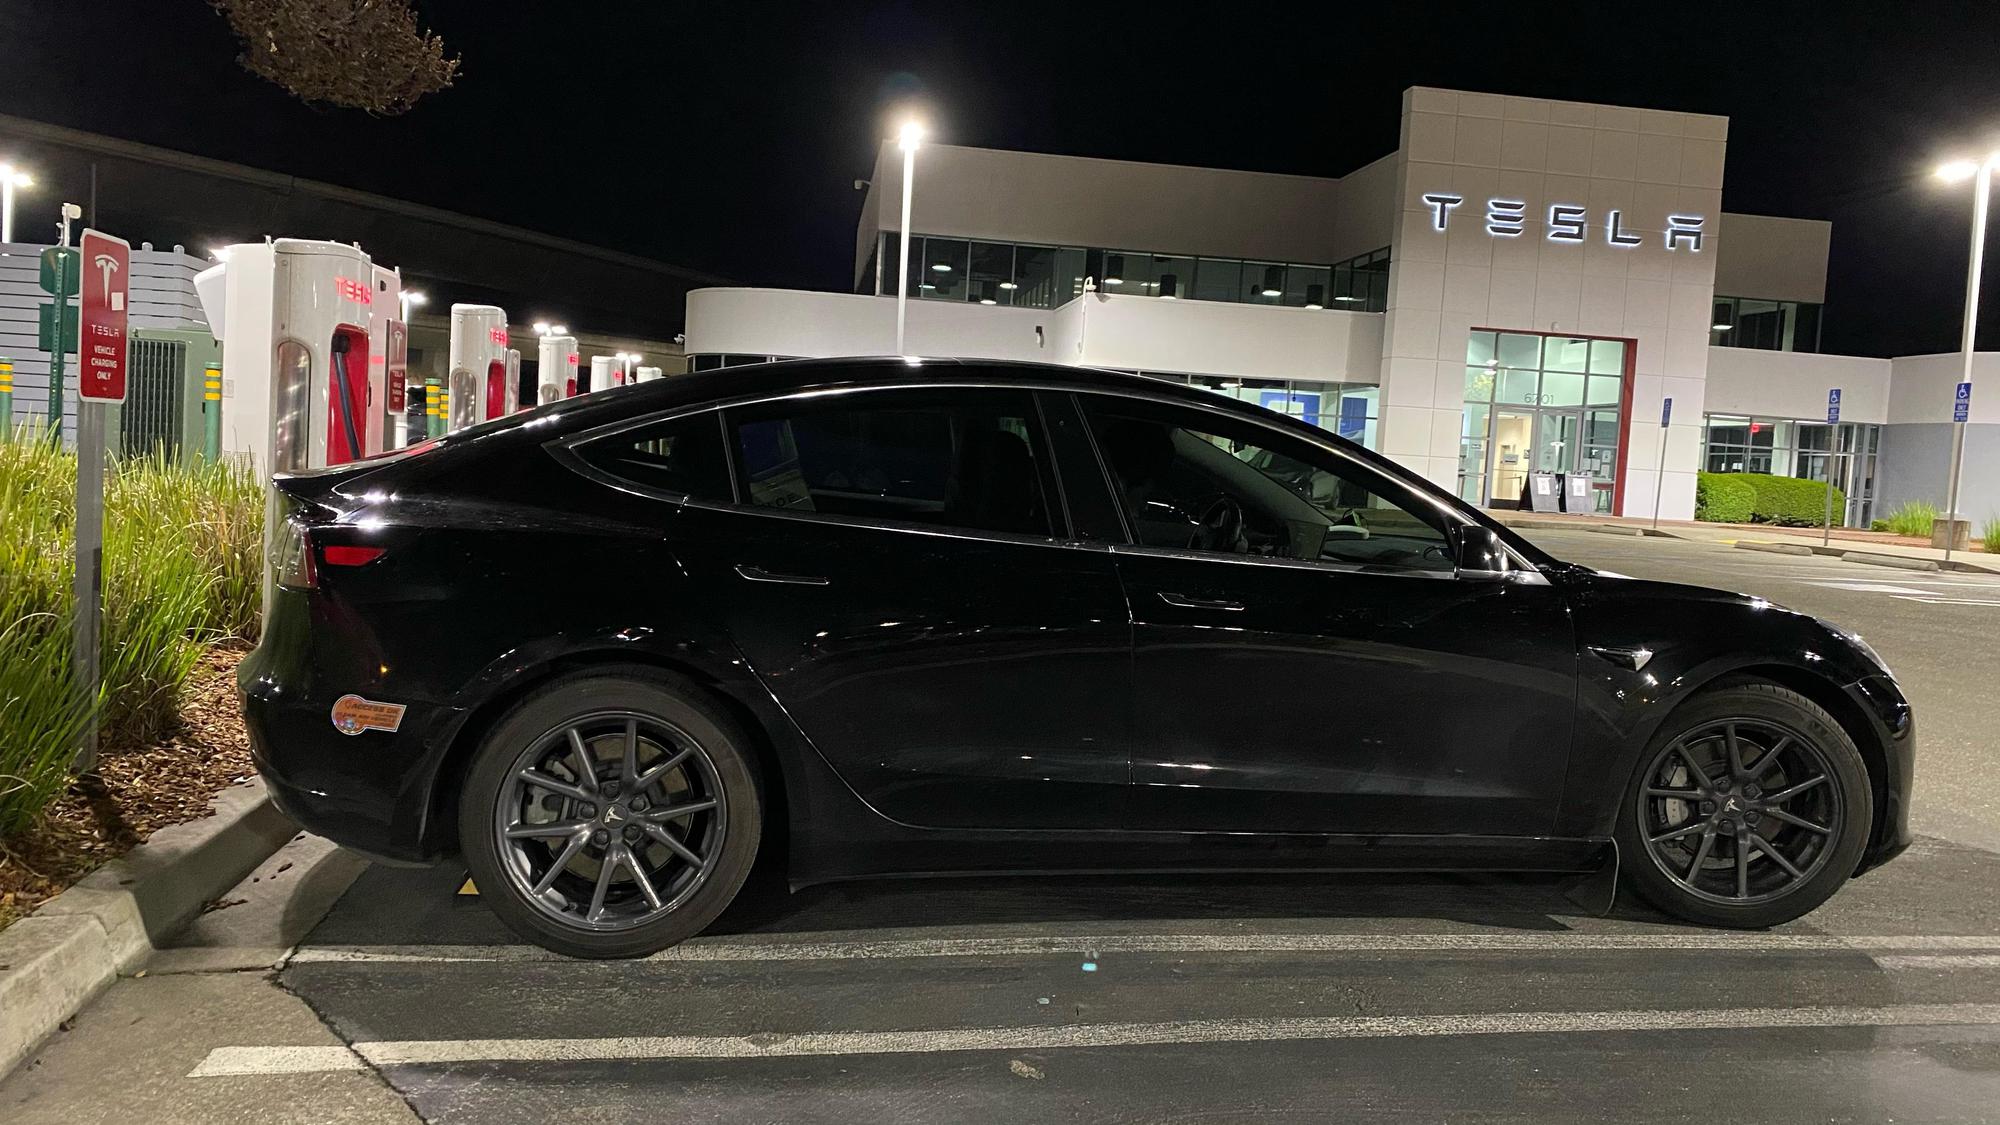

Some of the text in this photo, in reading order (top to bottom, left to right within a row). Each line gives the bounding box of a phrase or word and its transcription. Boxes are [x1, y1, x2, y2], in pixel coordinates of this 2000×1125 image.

[1422, 194, 1704, 251] TESLA
[91, 324, 120, 338] TESLA
[94, 345, 116, 356] VEHICLE
[91, 357, 118, 369] CHARGING
[96, 370, 111, 380] ONLY
[1524, 392, 1554, 405] 6701
